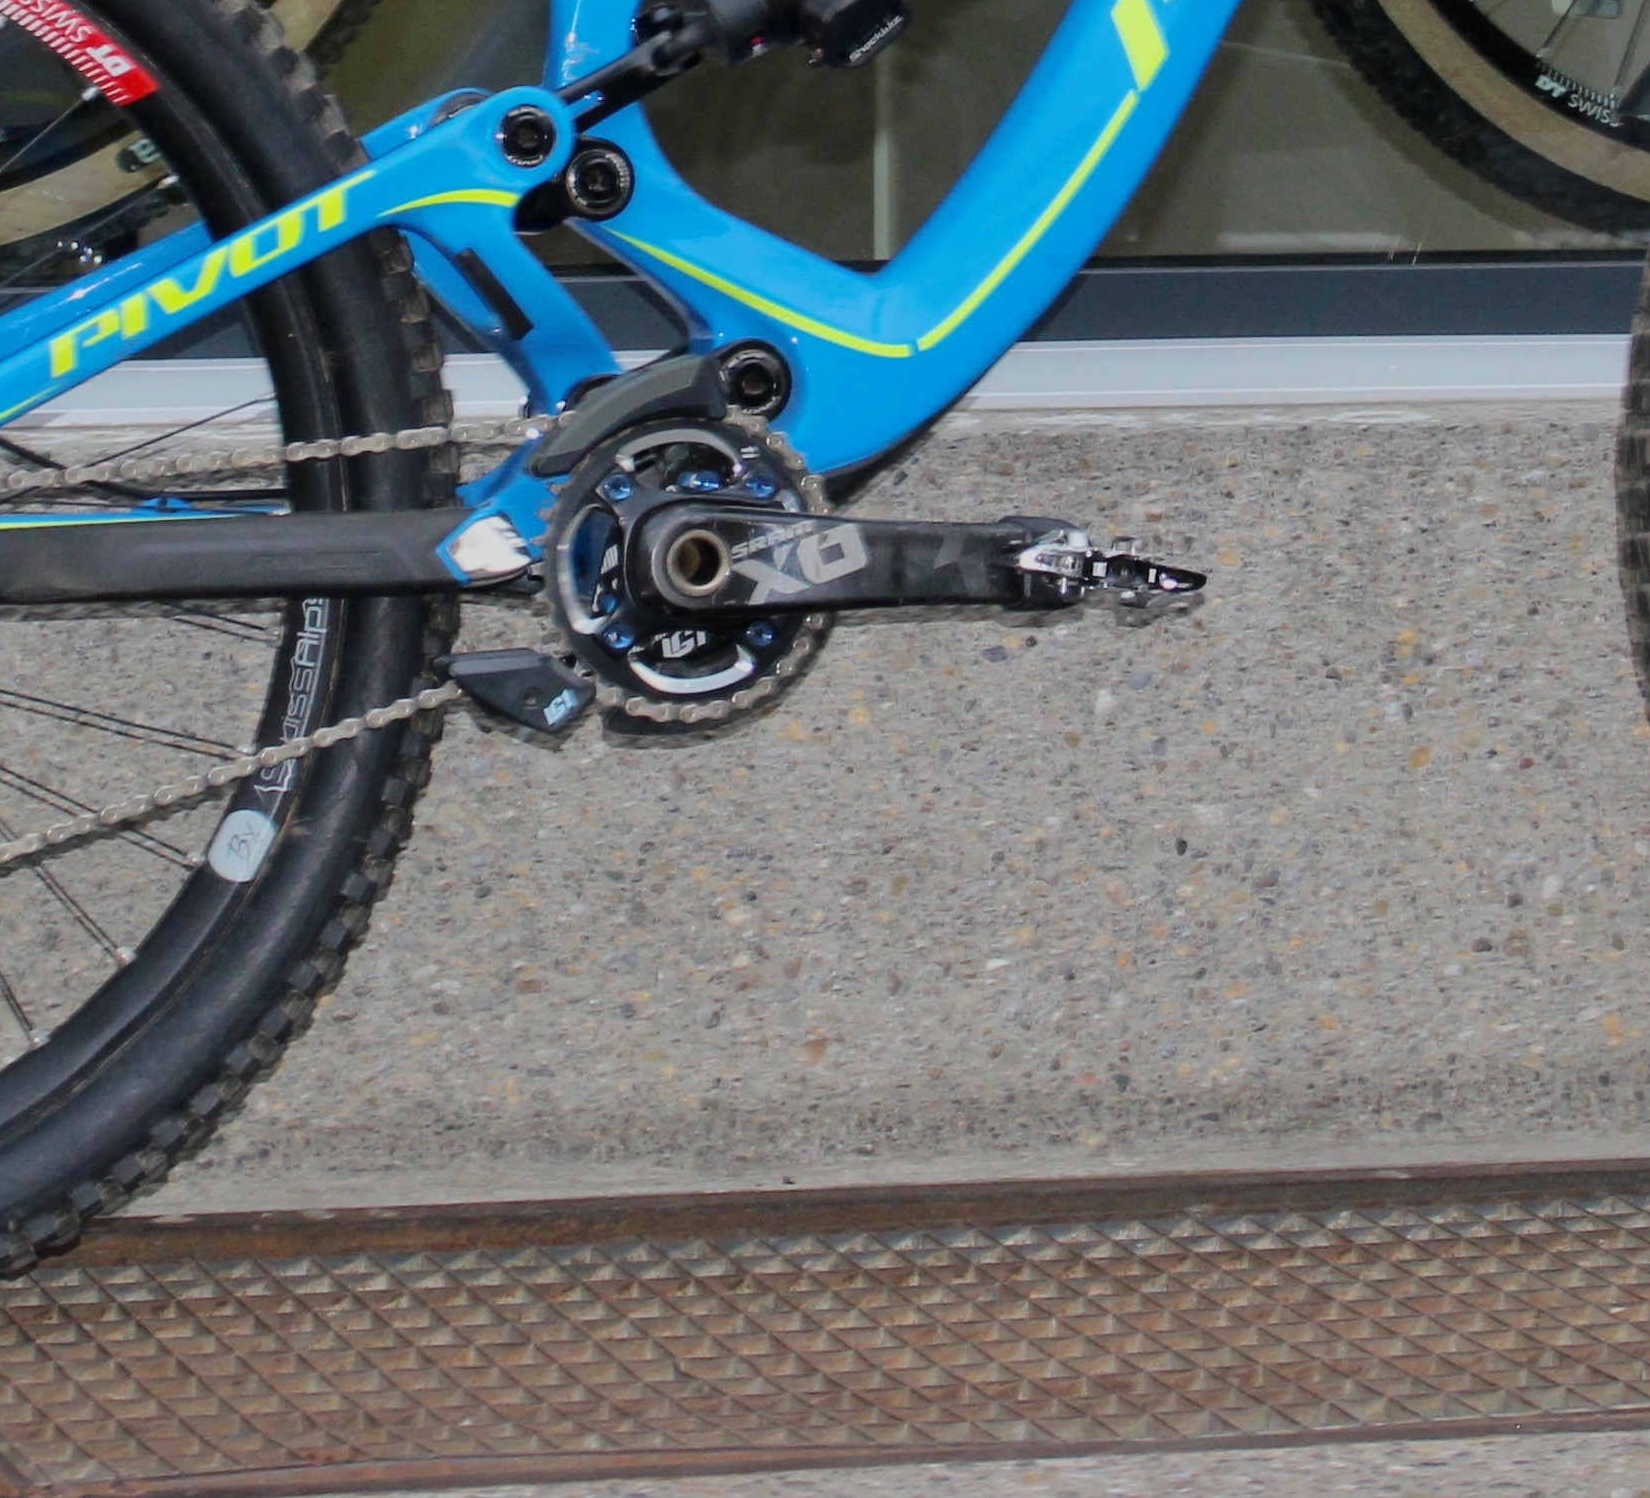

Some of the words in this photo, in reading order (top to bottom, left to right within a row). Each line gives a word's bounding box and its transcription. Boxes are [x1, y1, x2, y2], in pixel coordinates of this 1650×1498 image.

[84, 43, 133, 78] DT
[1534, 74, 1568, 98] DT
[50, 168, 378, 378] PIVOT
[730, 519, 816, 561] SRAM
